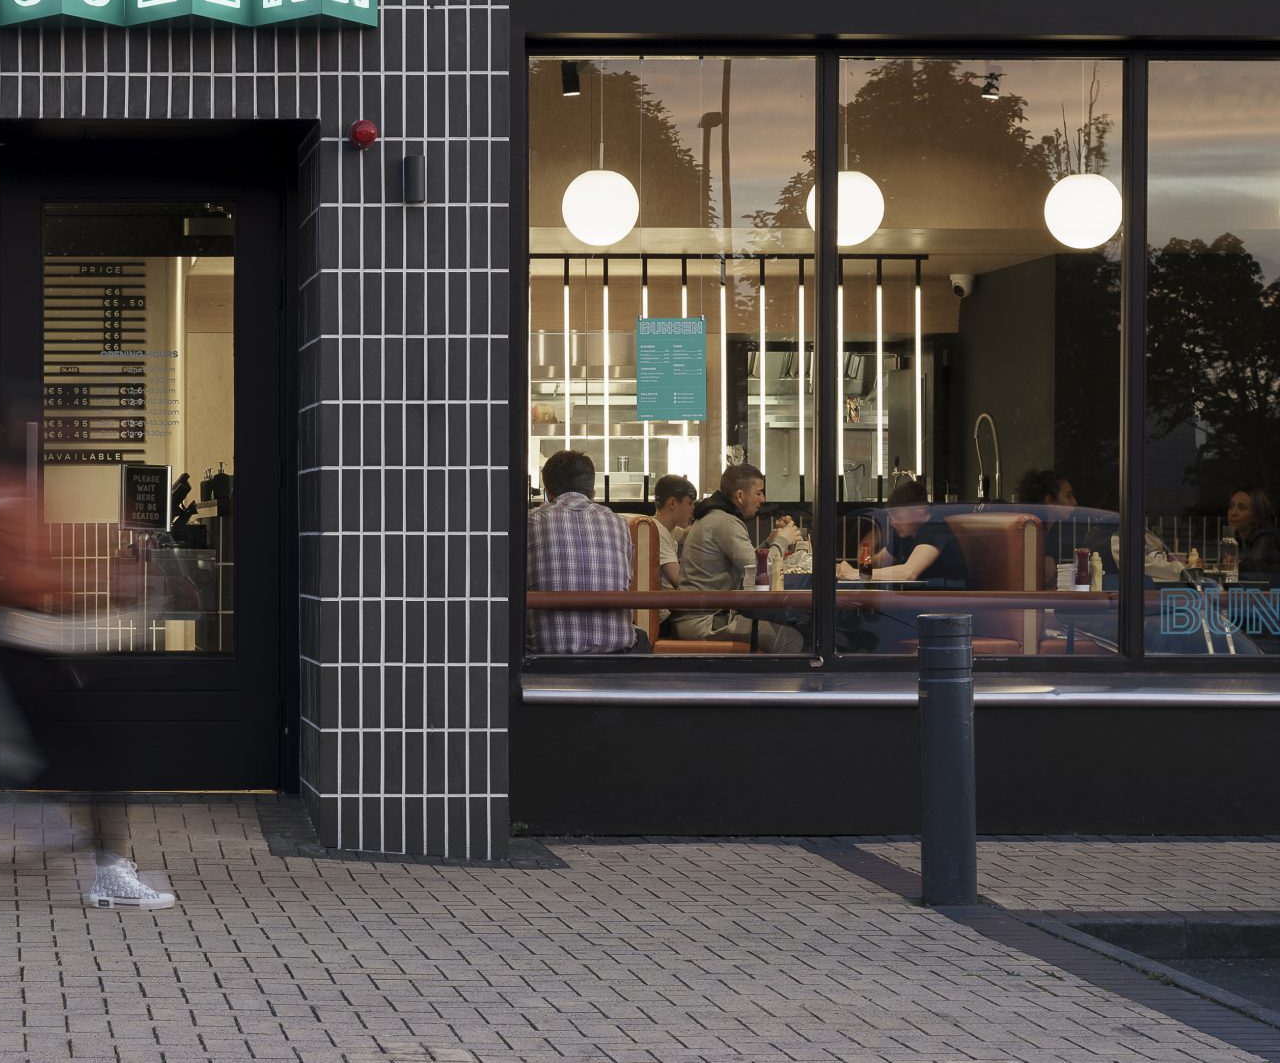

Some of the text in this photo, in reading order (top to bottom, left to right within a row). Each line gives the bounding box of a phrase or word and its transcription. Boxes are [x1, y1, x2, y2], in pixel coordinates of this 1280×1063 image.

[81, 266, 121, 274] PRICE
[105, 288, 120, 296] €6
[104, 299, 144, 307] €5.50
[105, 310, 120, 318] €6
[105, 321, 119, 329] €6
[640, 321, 703, 334] BUNSEN
[105, 332, 120, 340] €6
[105, 343, 119, 351] €6
[48, 387, 88, 395] €5.95
[48, 398, 88, 406] €6.45
[48, 420, 88, 428] €5.95
[48, 431, 88, 439] €6.45
[48, 453, 121, 461] AVAILABLE
[132, 474, 160, 483] PLEASE
[136, 484, 156, 492] WAIT
[136, 494, 156, 502] HERE
[147, 503, 157, 511] BE
[131, 512, 160, 520] SEATED
